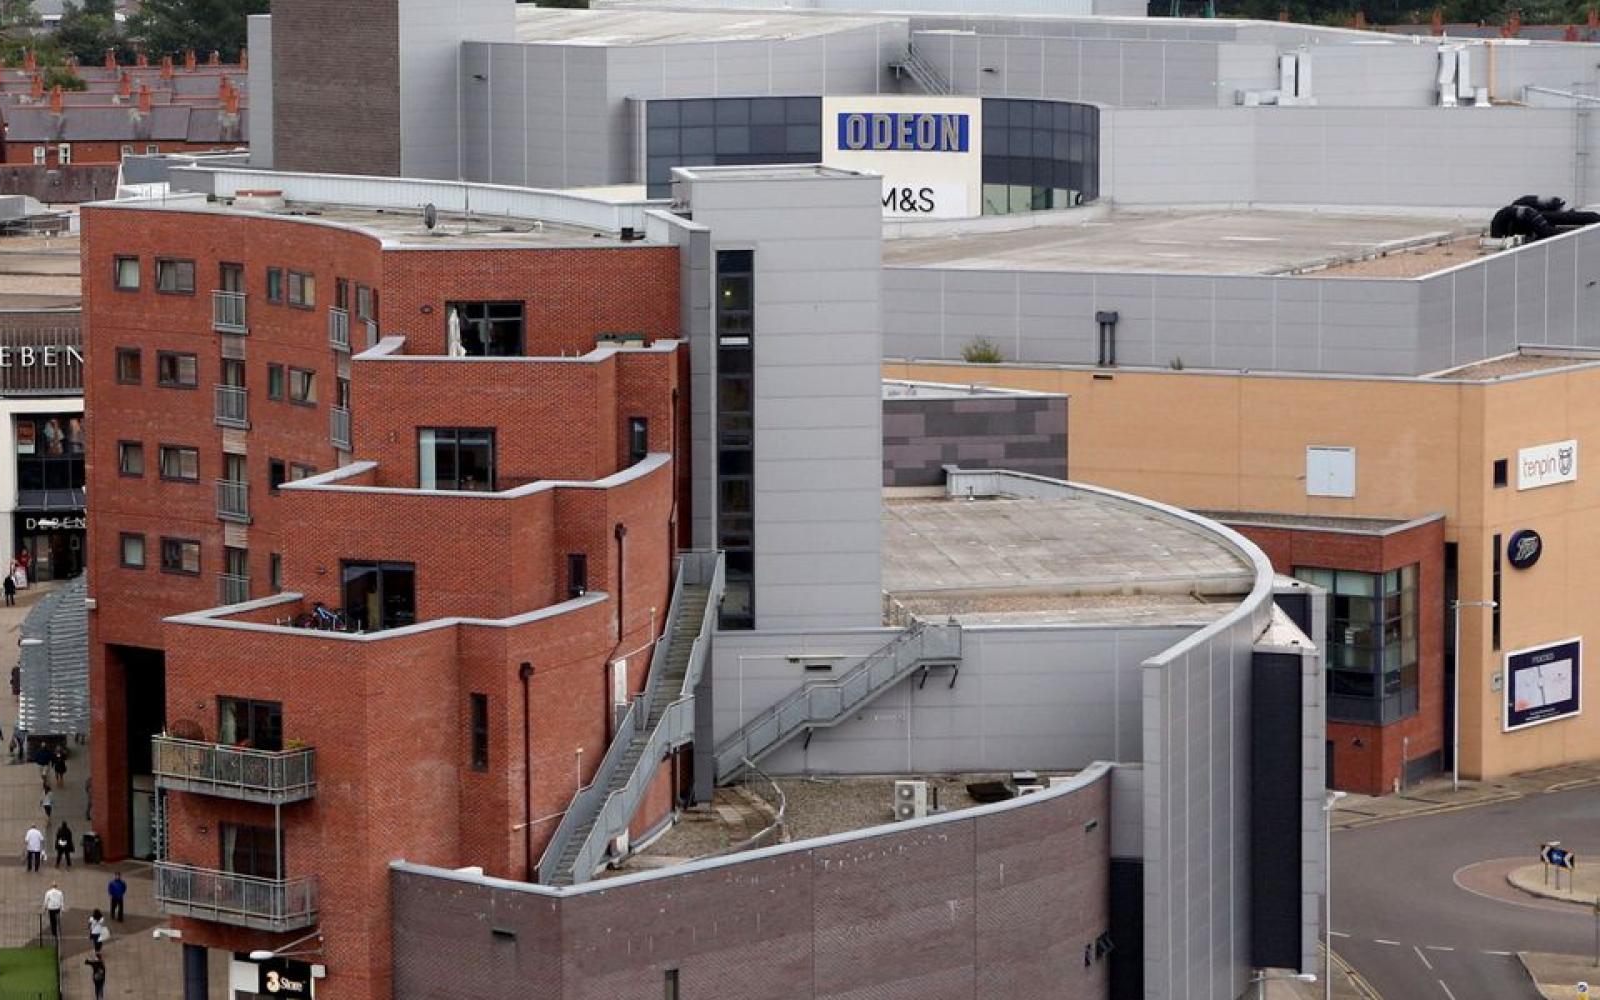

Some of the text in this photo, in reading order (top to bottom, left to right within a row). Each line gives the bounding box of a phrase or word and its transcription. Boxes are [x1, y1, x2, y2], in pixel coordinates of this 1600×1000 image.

[846, 113, 959, 151] ODEON
[881, 187, 935, 213] M&S
[1522, 455, 1556, 480] tenpin
